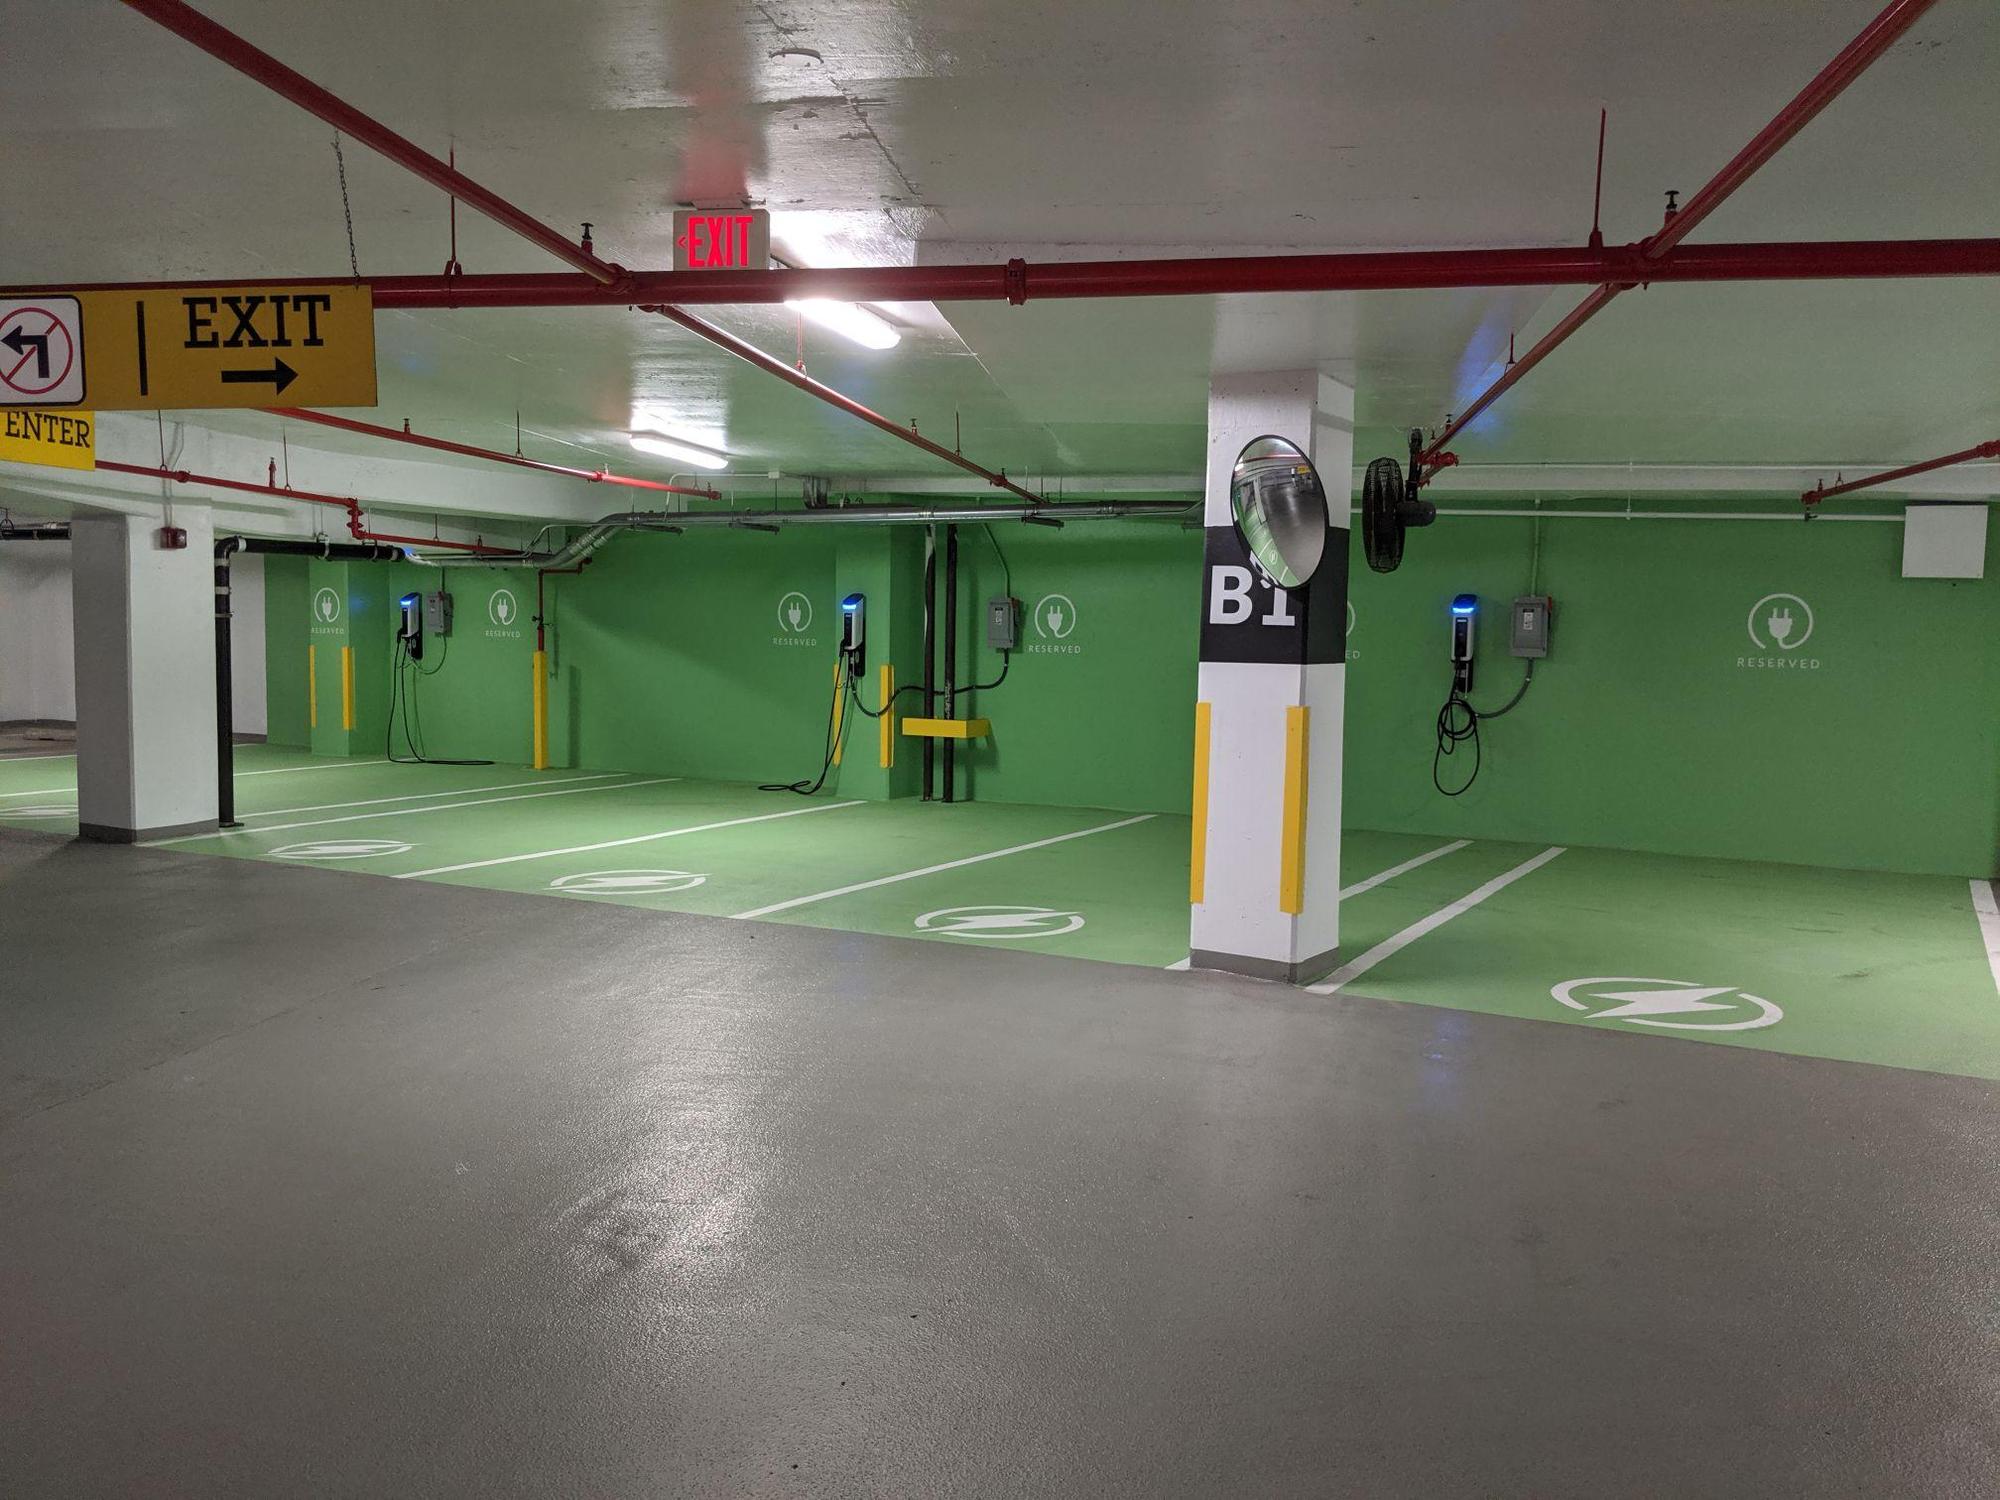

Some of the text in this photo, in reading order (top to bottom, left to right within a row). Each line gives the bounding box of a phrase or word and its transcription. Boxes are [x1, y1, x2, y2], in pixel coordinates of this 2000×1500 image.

[688, 215, 753, 268] EXIT
[182, 294, 331, 348] EXIT
[5, 410, 91, 449] ENTER
[773, 638, 817, 646] RESERVED
[1028, 645, 1081, 654] RESERVED
[1737, 657, 1820, 669] RESERVED
